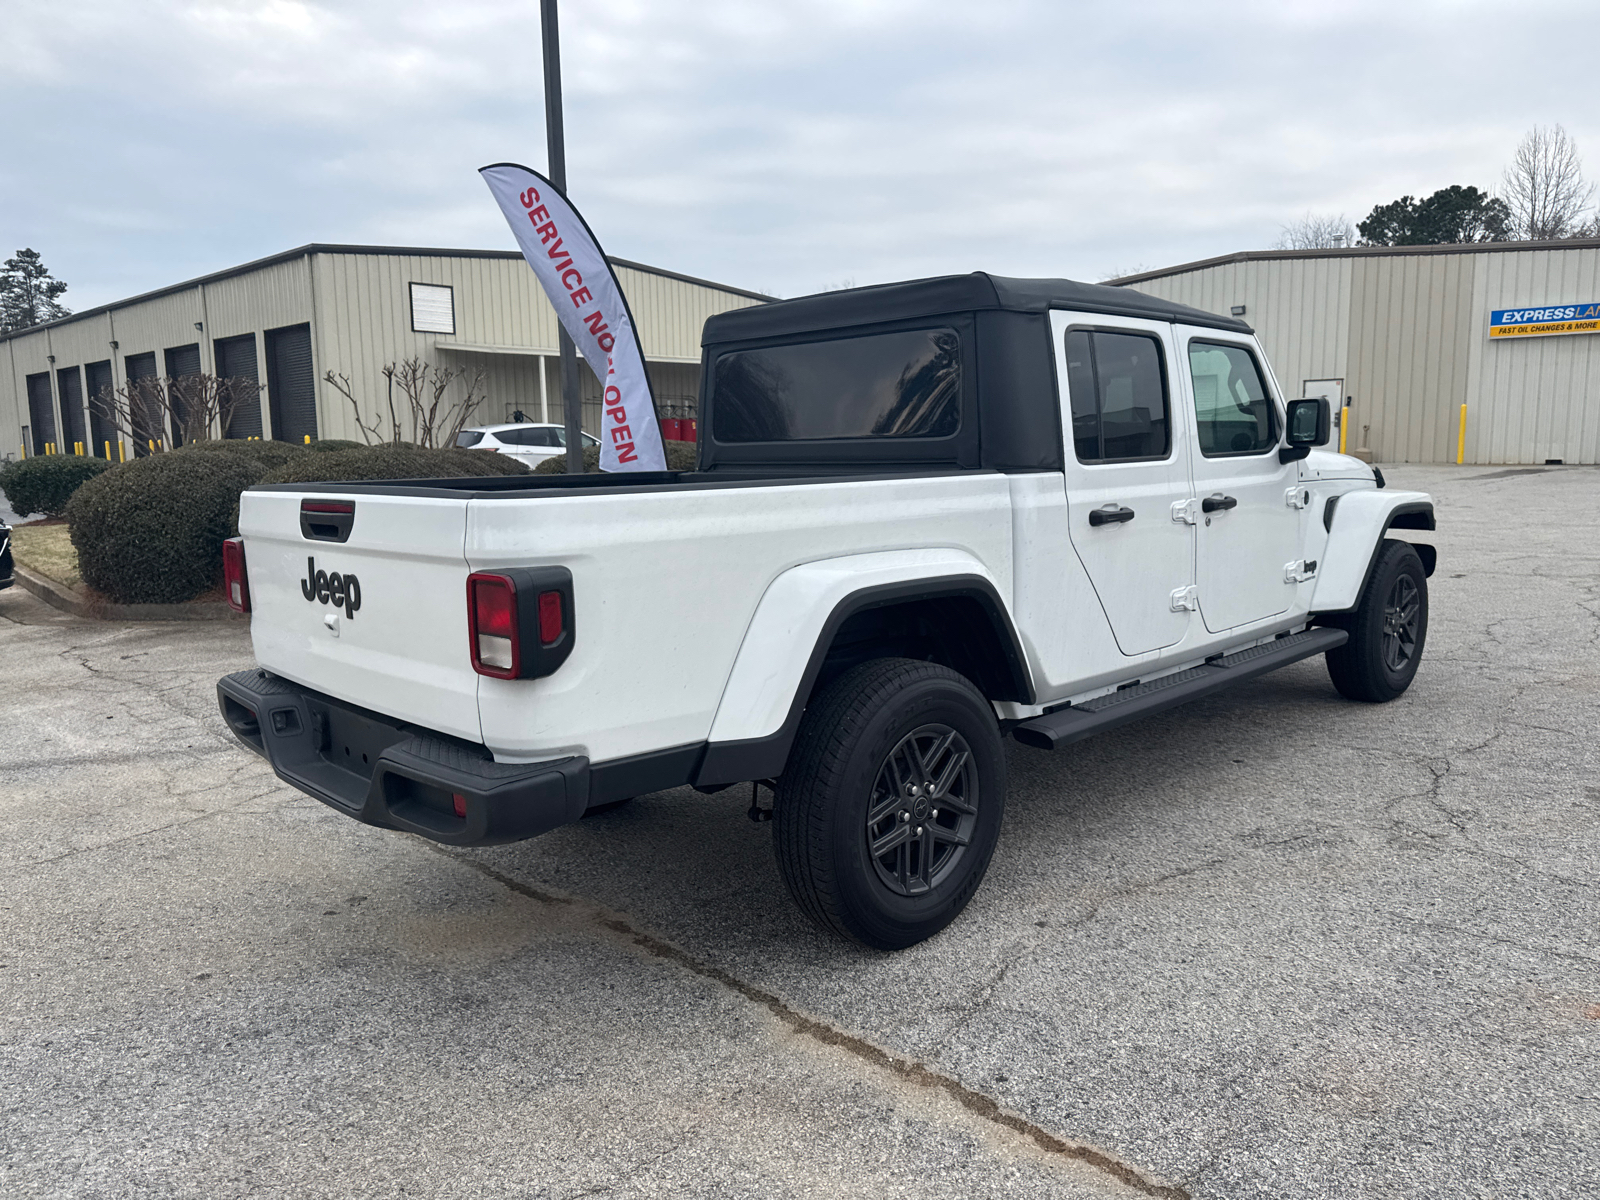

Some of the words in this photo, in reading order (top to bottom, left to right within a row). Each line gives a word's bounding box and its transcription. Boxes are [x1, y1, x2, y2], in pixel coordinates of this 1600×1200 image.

[519, 187, 593, 308] SERVICE
[583, 310, 616, 375] NO
[604, 385, 638, 464] OPEN
[1498, 326, 1516, 334] FAST
[1530, 323, 1565, 333] CHANGES
[1574, 321, 1598, 330] MORE
[301, 556, 361, 620] Jeep
